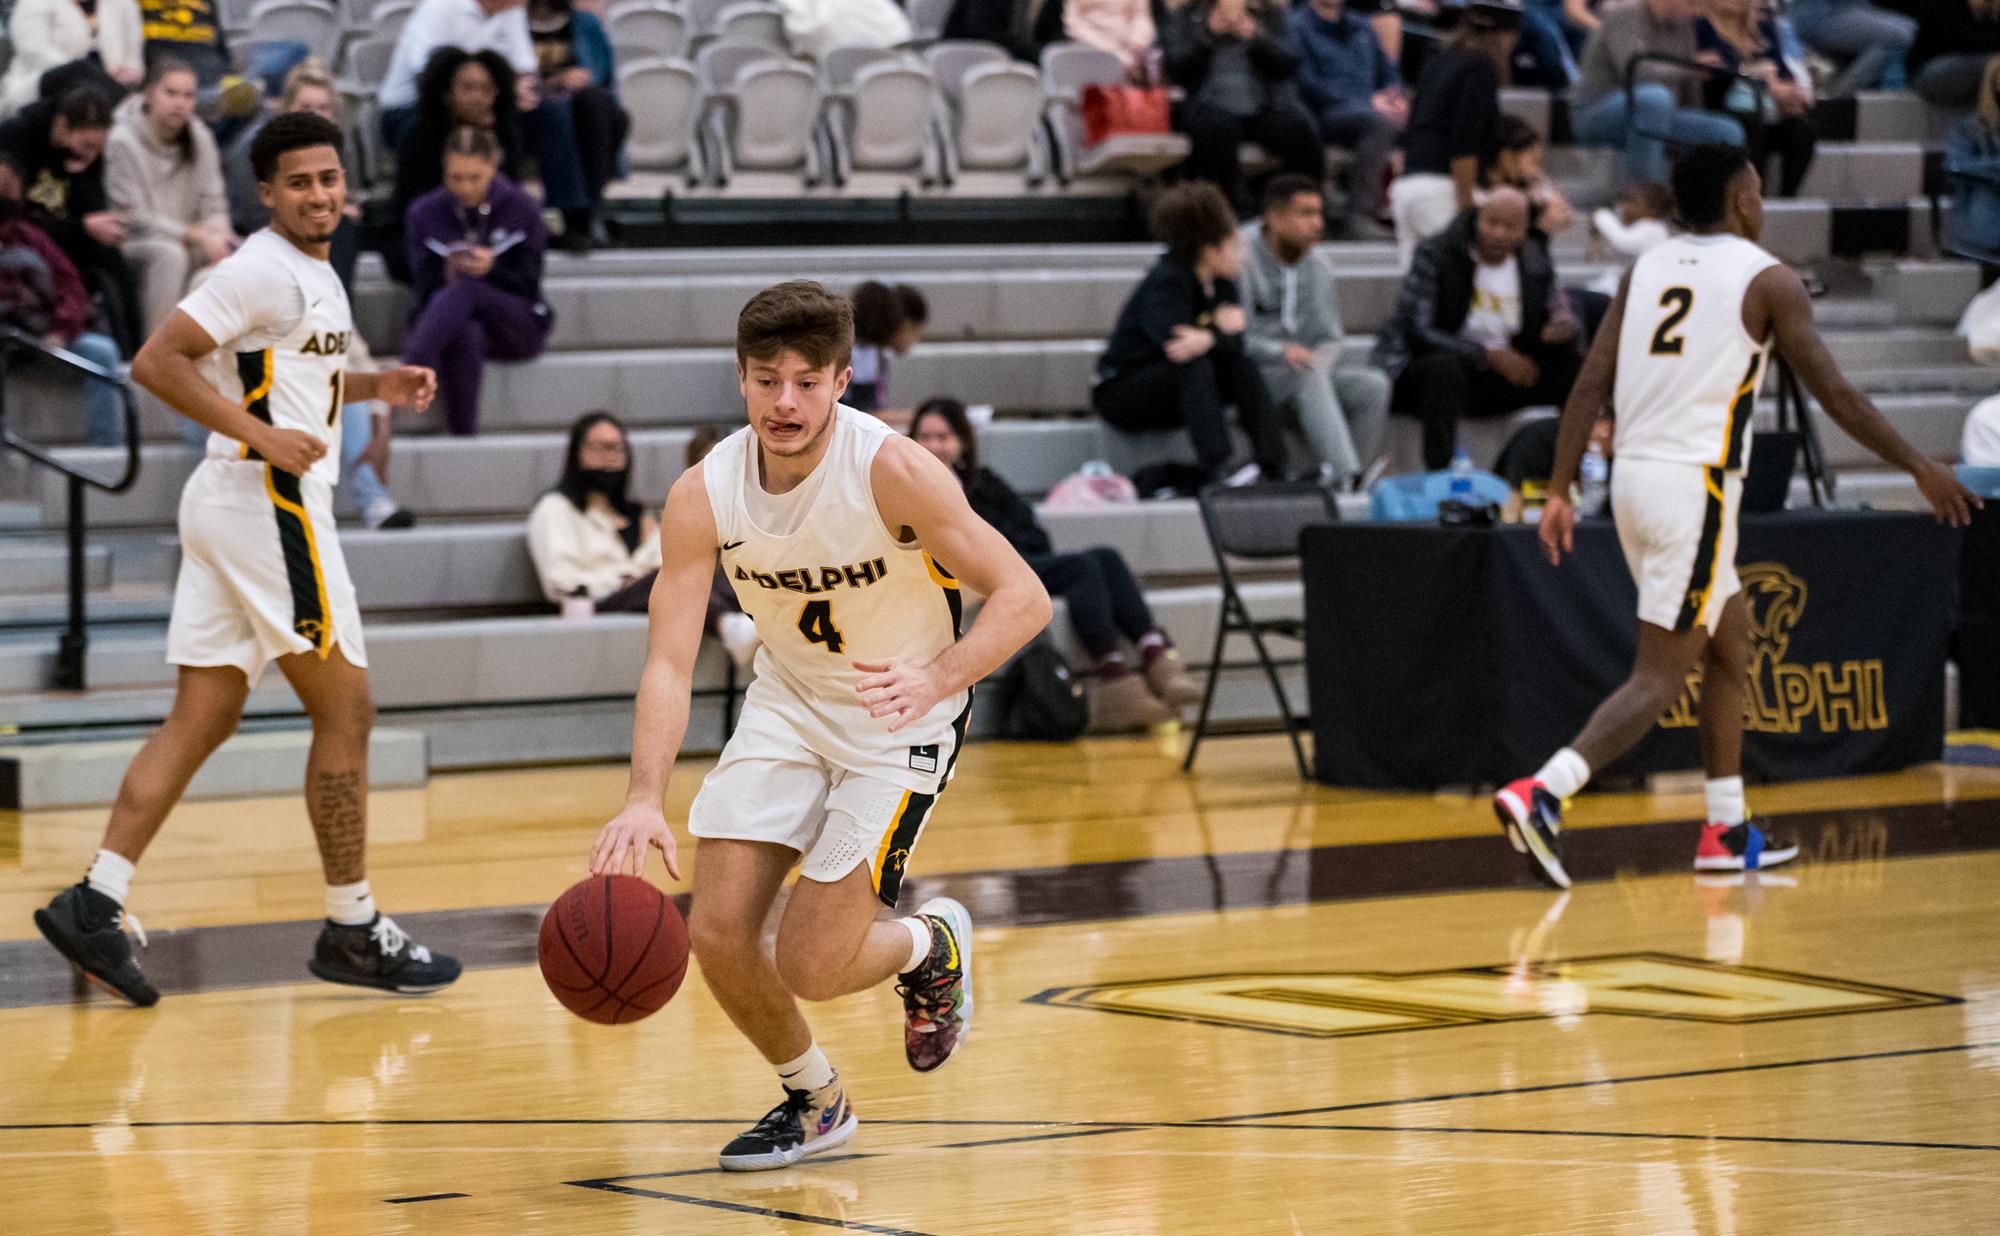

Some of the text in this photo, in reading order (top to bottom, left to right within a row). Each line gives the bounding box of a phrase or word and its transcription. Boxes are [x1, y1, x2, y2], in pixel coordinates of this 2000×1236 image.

[1649, 286, 1695, 356] 2
[735, 556, 888, 594] ADELPHI
[797, 599, 846, 654] 4
